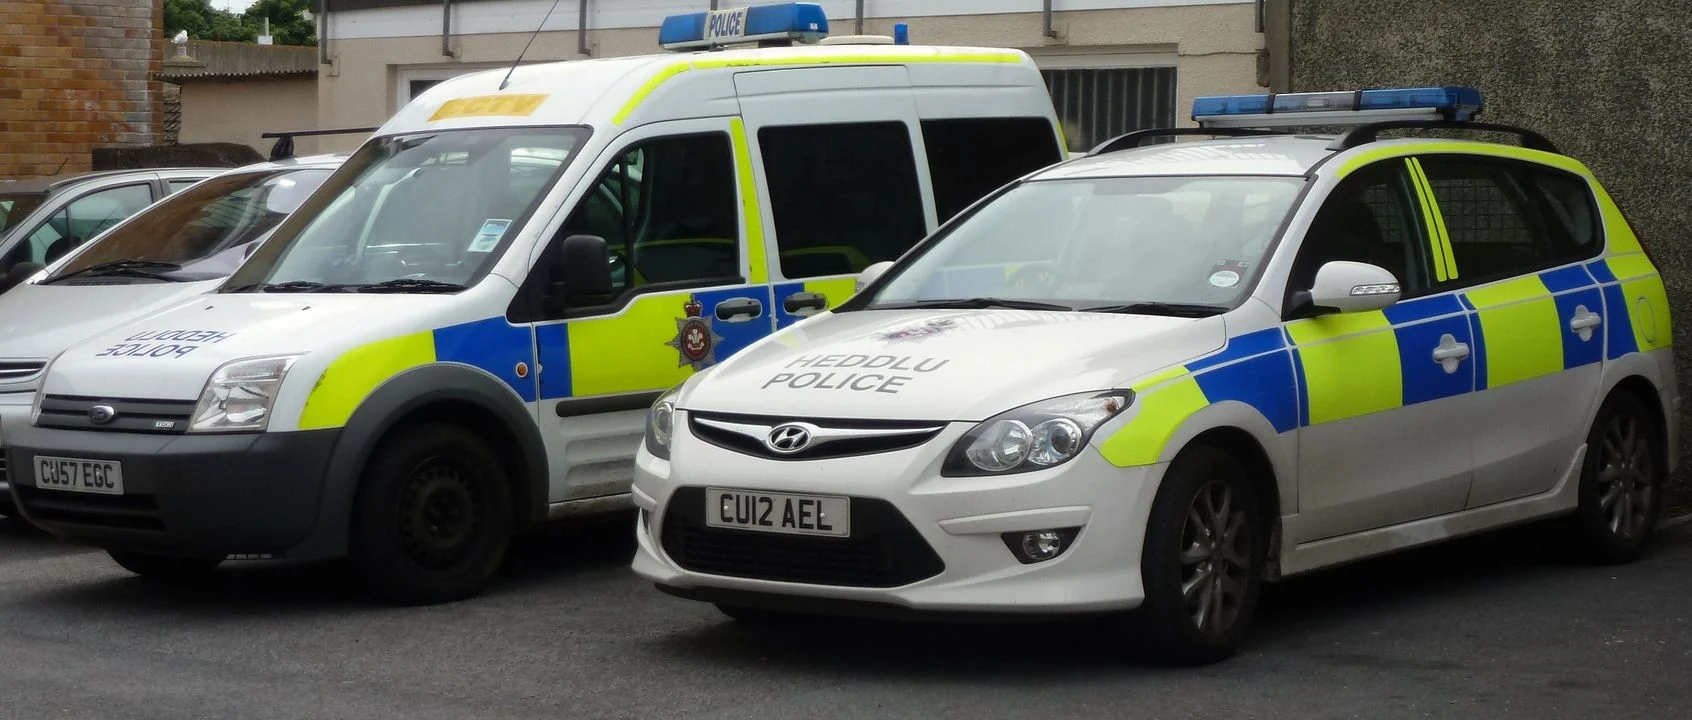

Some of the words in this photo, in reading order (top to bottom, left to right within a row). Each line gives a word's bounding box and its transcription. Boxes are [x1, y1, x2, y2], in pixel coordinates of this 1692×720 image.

[710, 12, 742, 37] POLICE
[440, 96, 541, 116] CCTV
[784, 354, 950, 372] HEDDLU
[761, 372, 913, 394] POLICE
[40, 459, 78, 486] CU57
[83, 463, 114, 489] EGC
[720, 493, 773, 527] CU12
[781, 498, 833, 531] AEL
